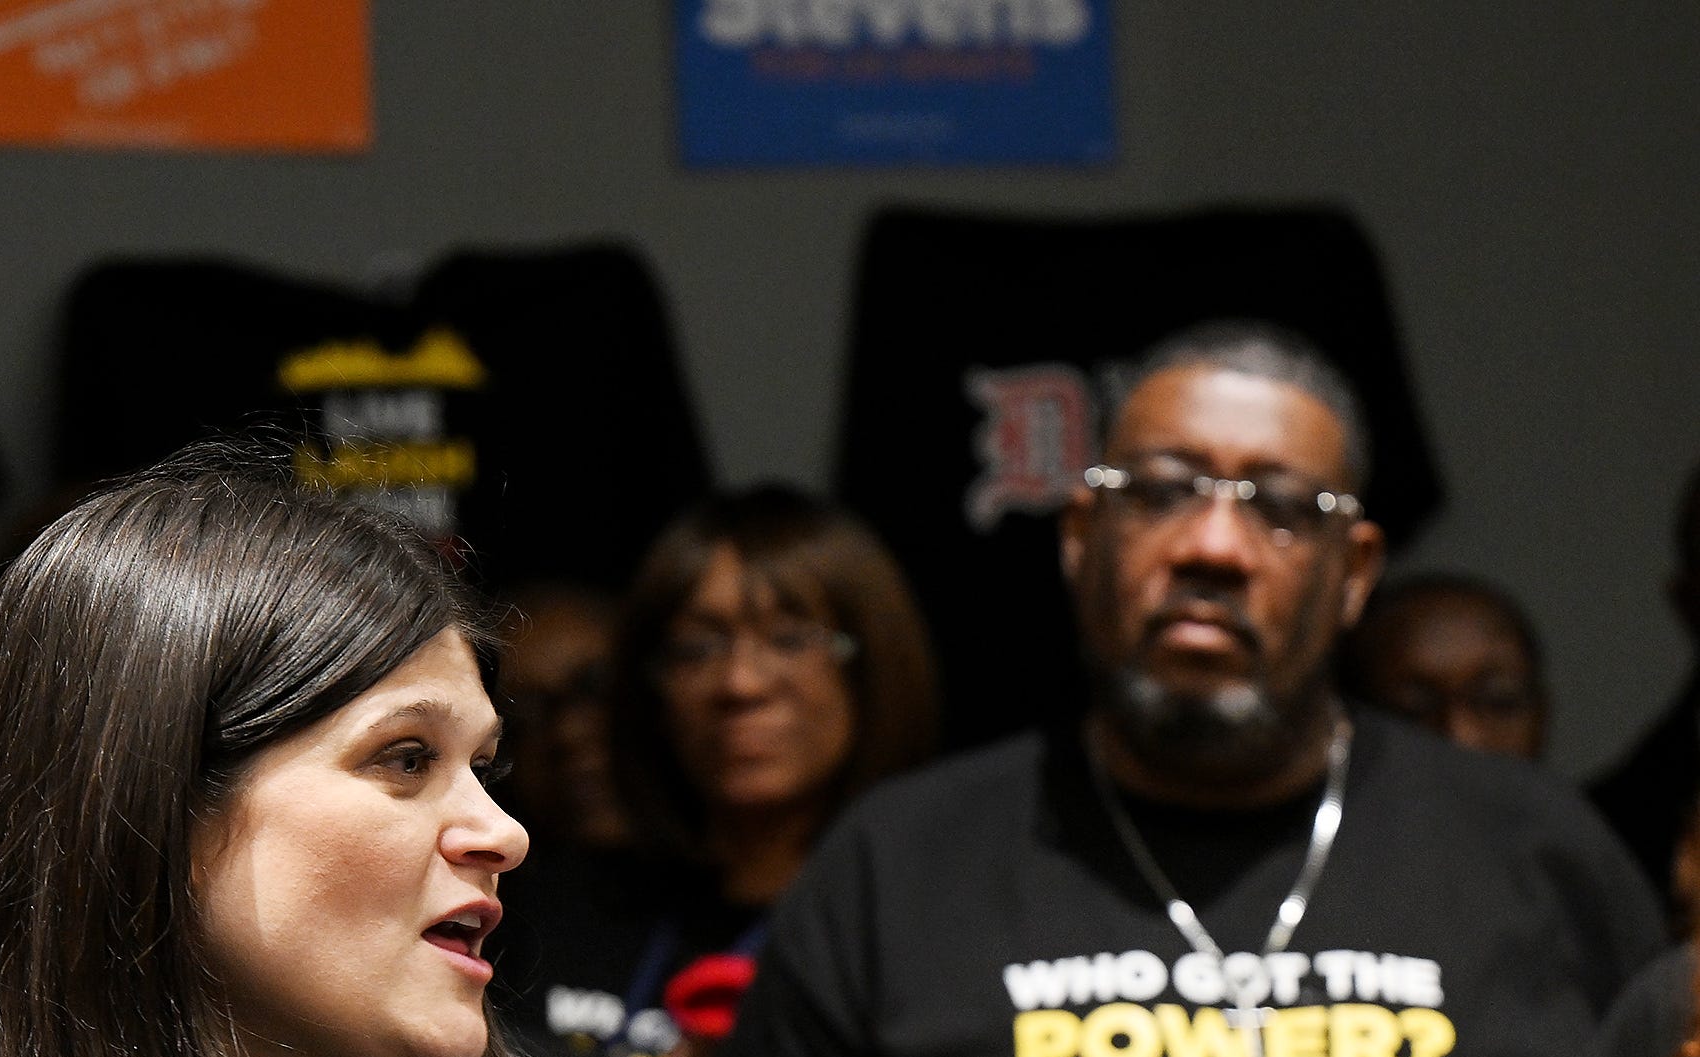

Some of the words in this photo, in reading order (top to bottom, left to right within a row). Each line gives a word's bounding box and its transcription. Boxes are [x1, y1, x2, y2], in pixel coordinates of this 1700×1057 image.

[1003, 950, 1168, 1010] WHO
[1172, 951, 1310, 1004] GOT
[1315, 950, 1443, 1007] THE
